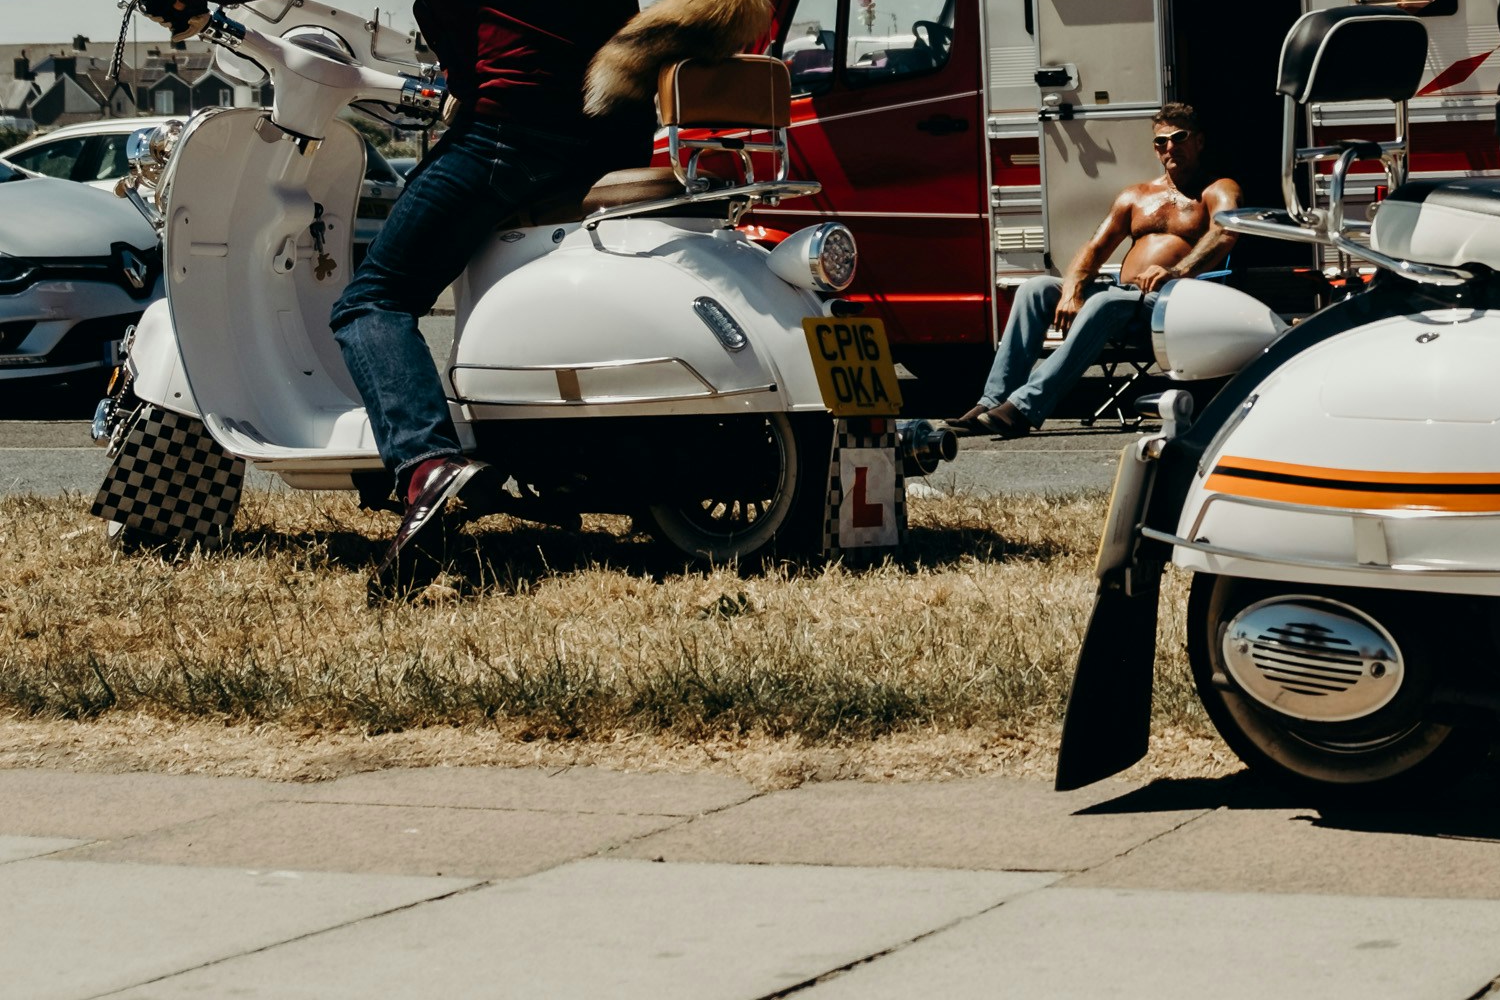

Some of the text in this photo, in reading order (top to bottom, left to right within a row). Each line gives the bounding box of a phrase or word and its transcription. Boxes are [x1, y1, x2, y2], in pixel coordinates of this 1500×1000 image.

[815, 323, 880, 362] CP16
[830, 366, 890, 404] OKA
[852, 466, 884, 528] L
